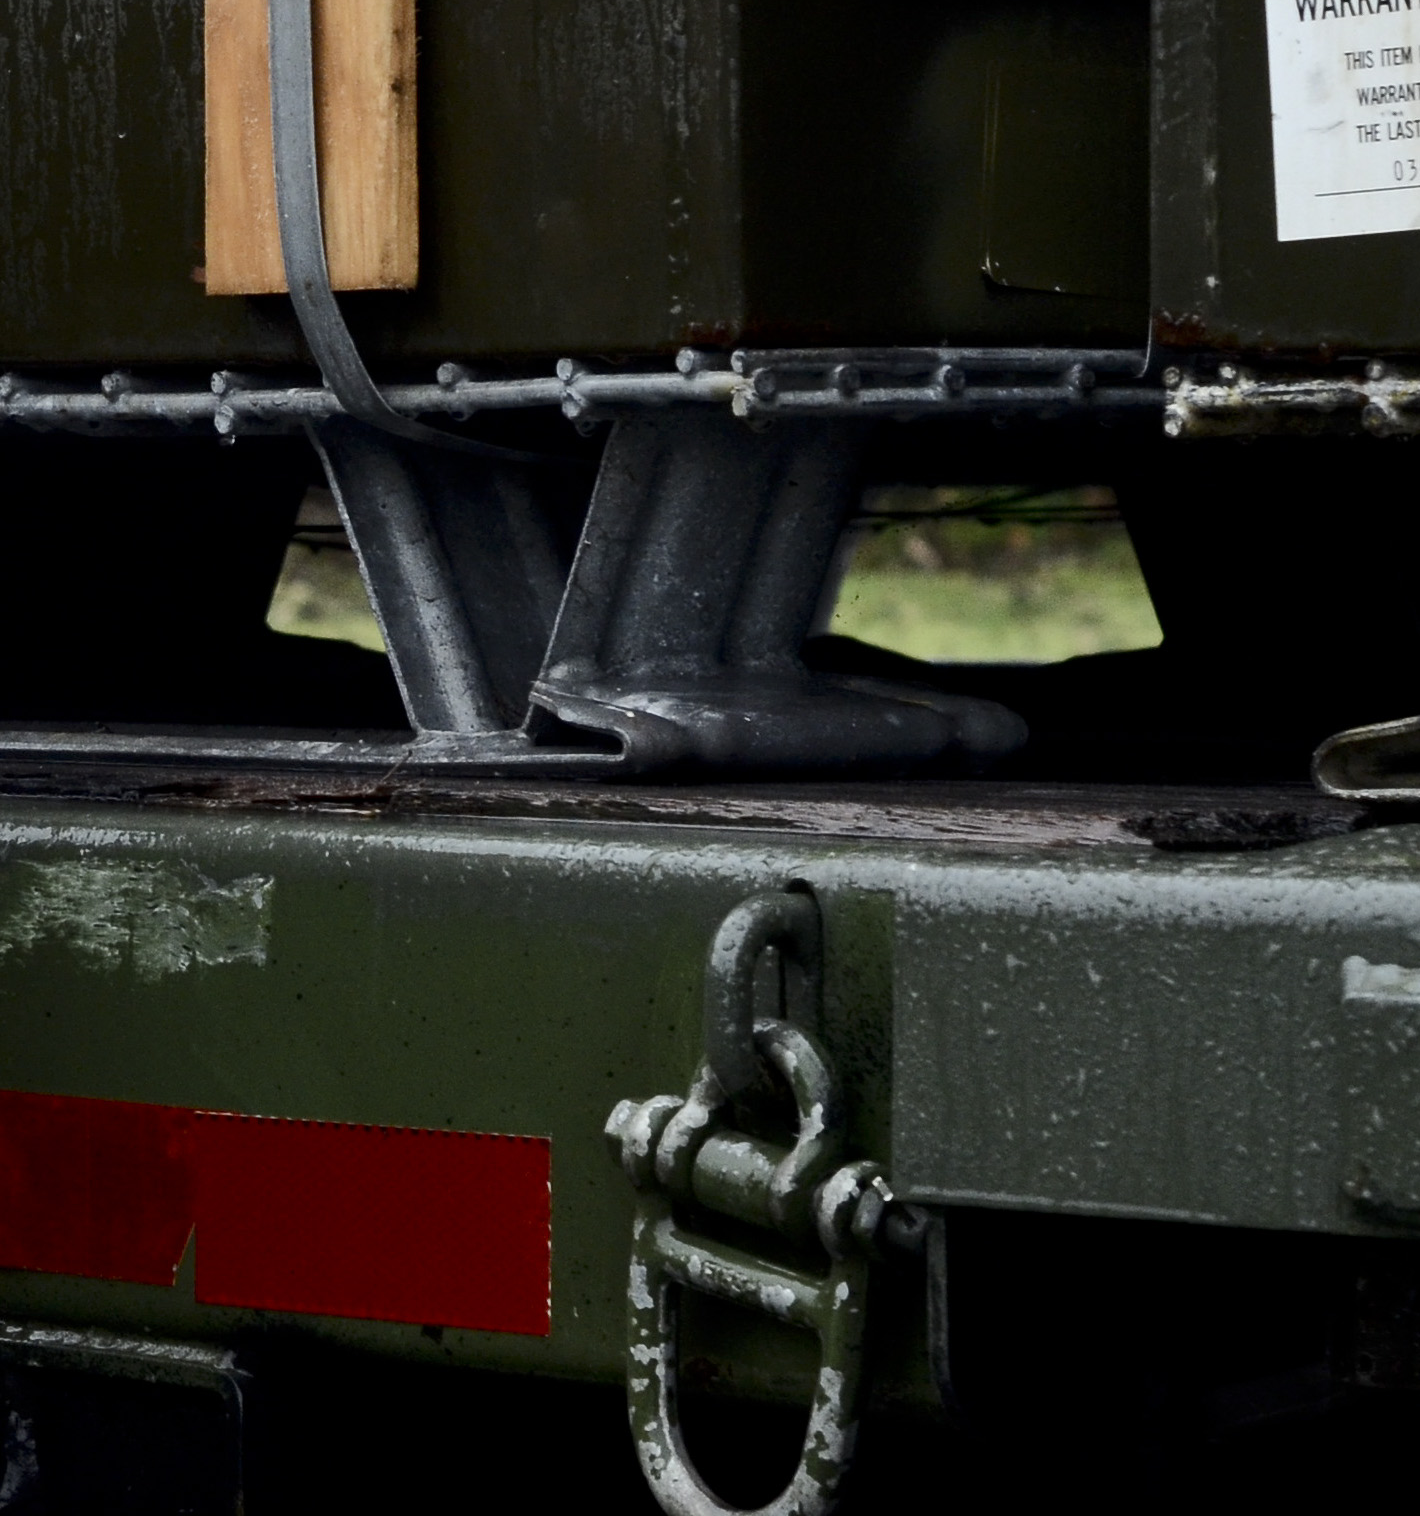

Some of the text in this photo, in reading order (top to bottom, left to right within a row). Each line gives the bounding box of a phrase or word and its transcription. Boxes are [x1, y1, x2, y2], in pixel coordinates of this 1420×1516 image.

[1345, 46, 1412, 71] THIS ITEM
[1357, 120, 1420, 144] THE LAST
